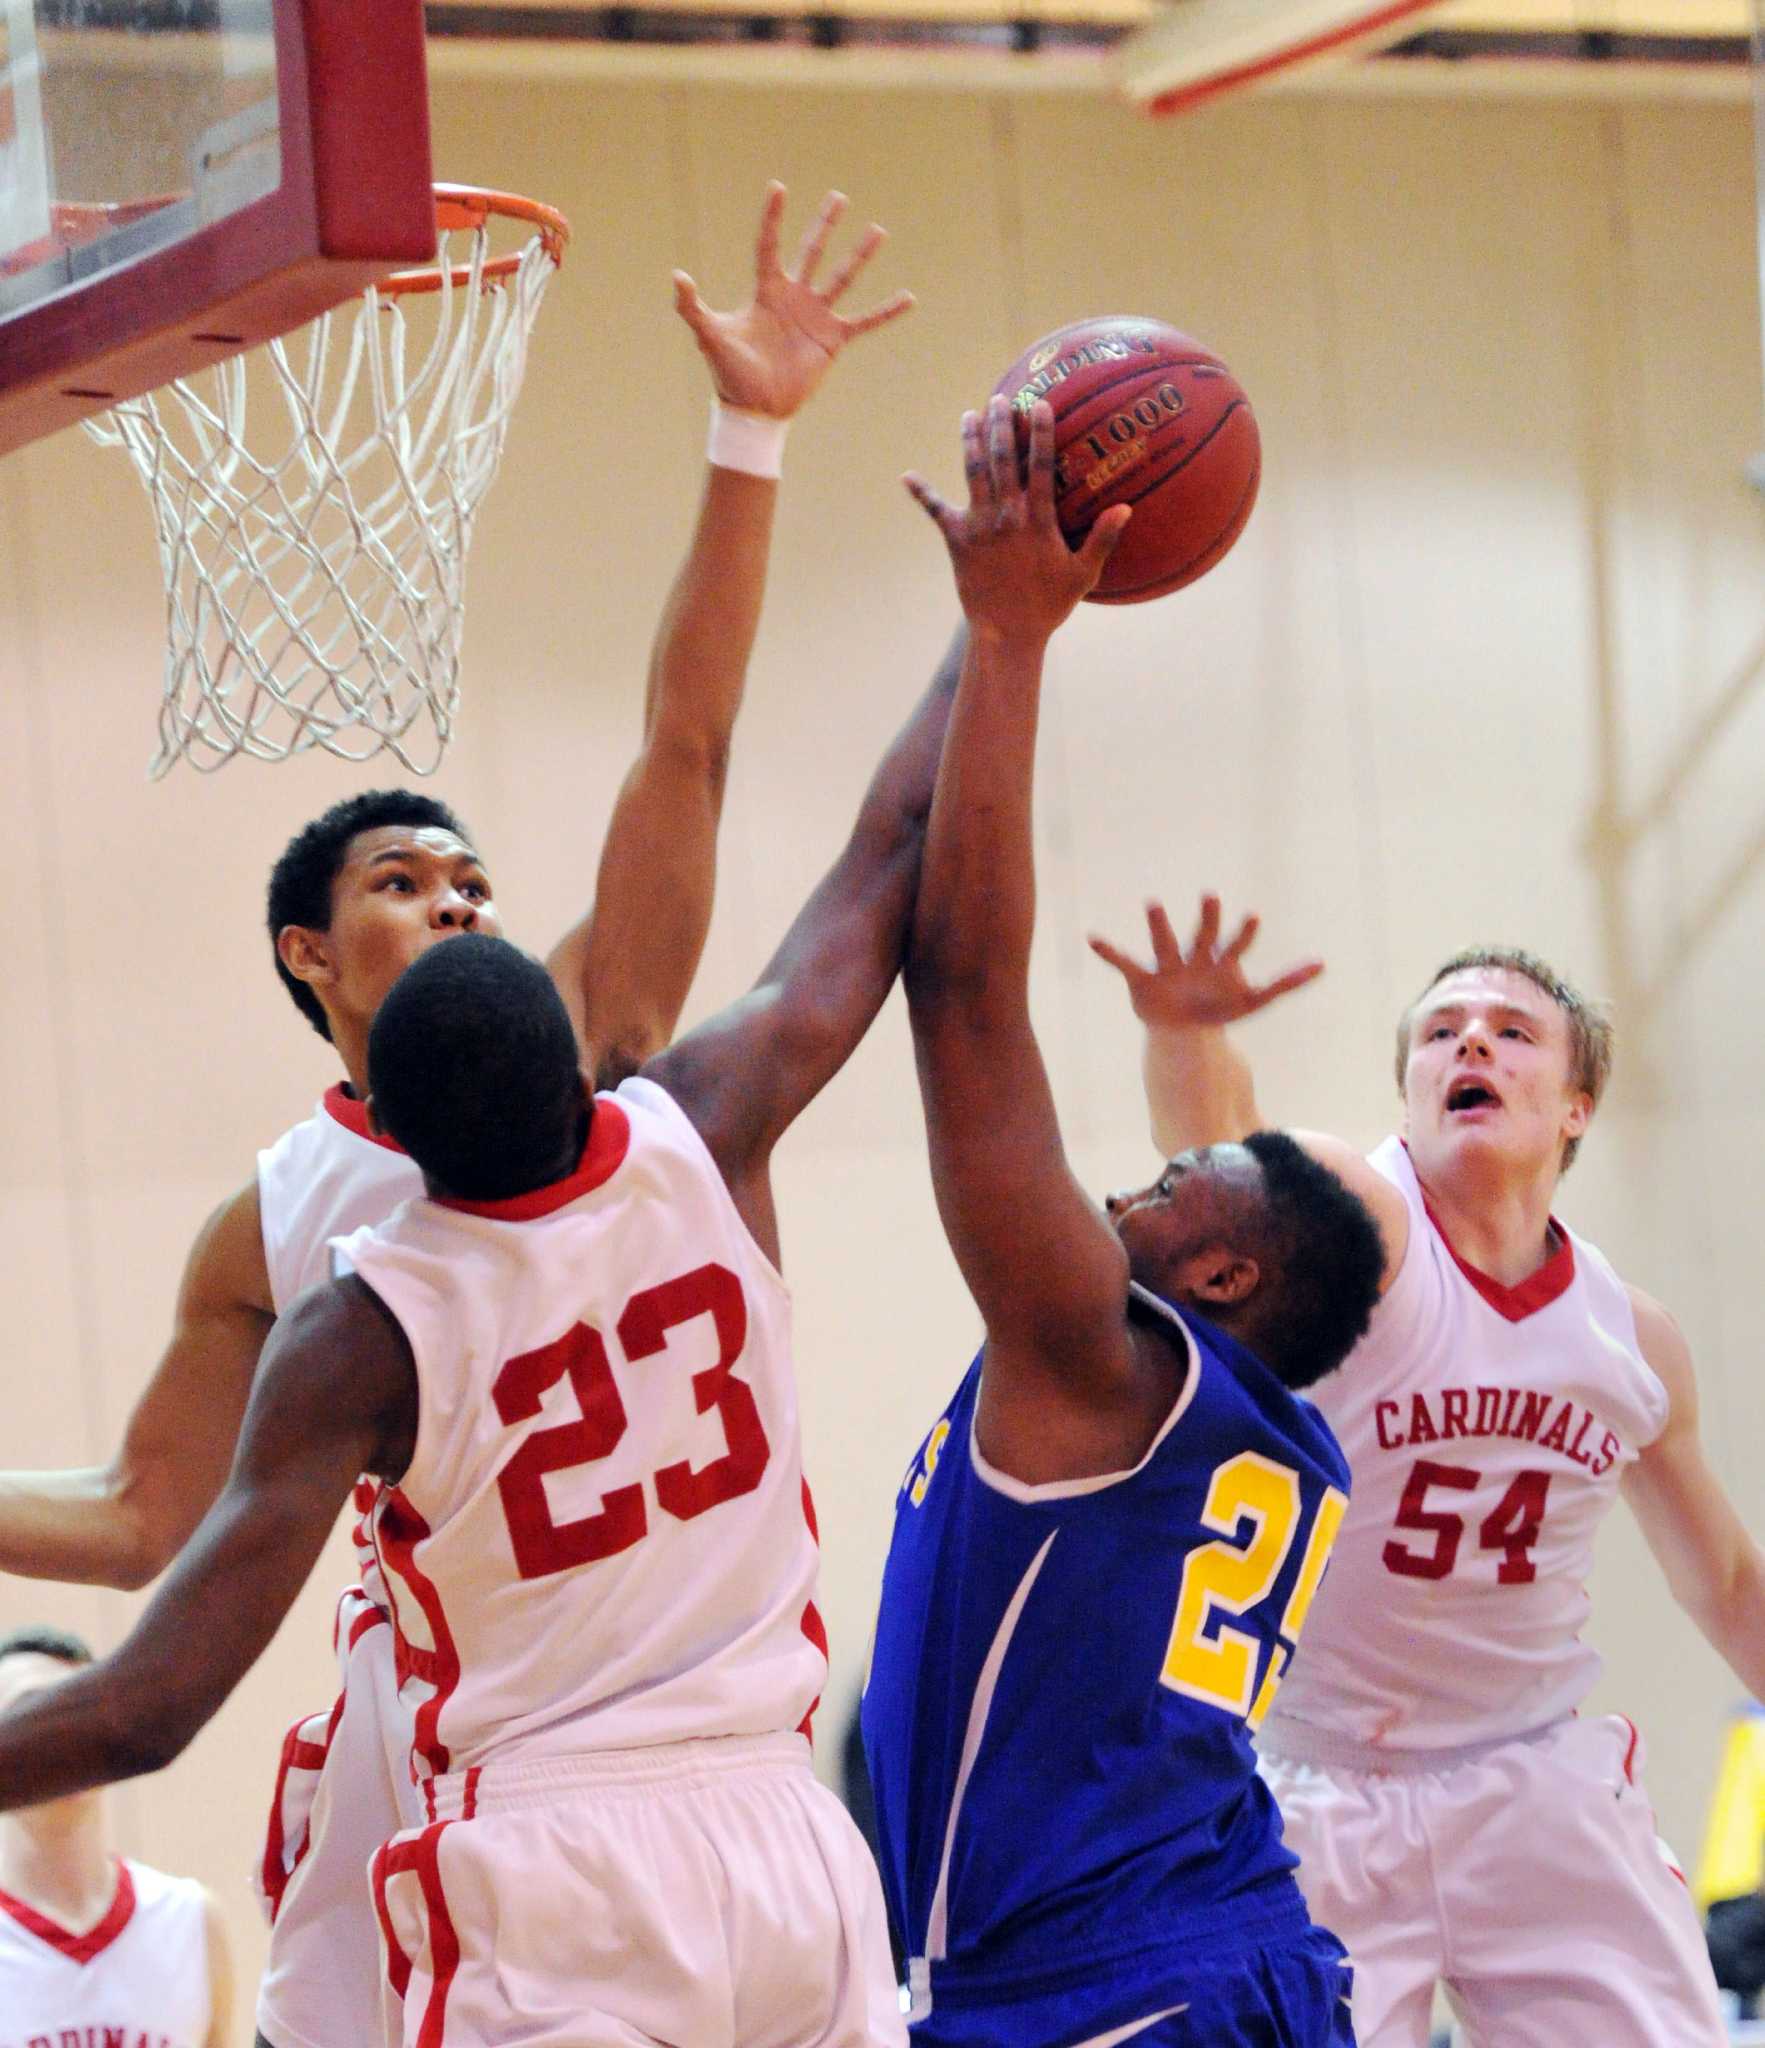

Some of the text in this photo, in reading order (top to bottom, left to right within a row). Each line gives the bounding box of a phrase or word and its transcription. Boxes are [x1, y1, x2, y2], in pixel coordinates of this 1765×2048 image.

[1086, 384, 1184, 460] 1000
[491, 1262, 770, 1579] 23
[1375, 1386, 1620, 1476] CARDINALS
[1382, 1459, 1552, 1585] 54
